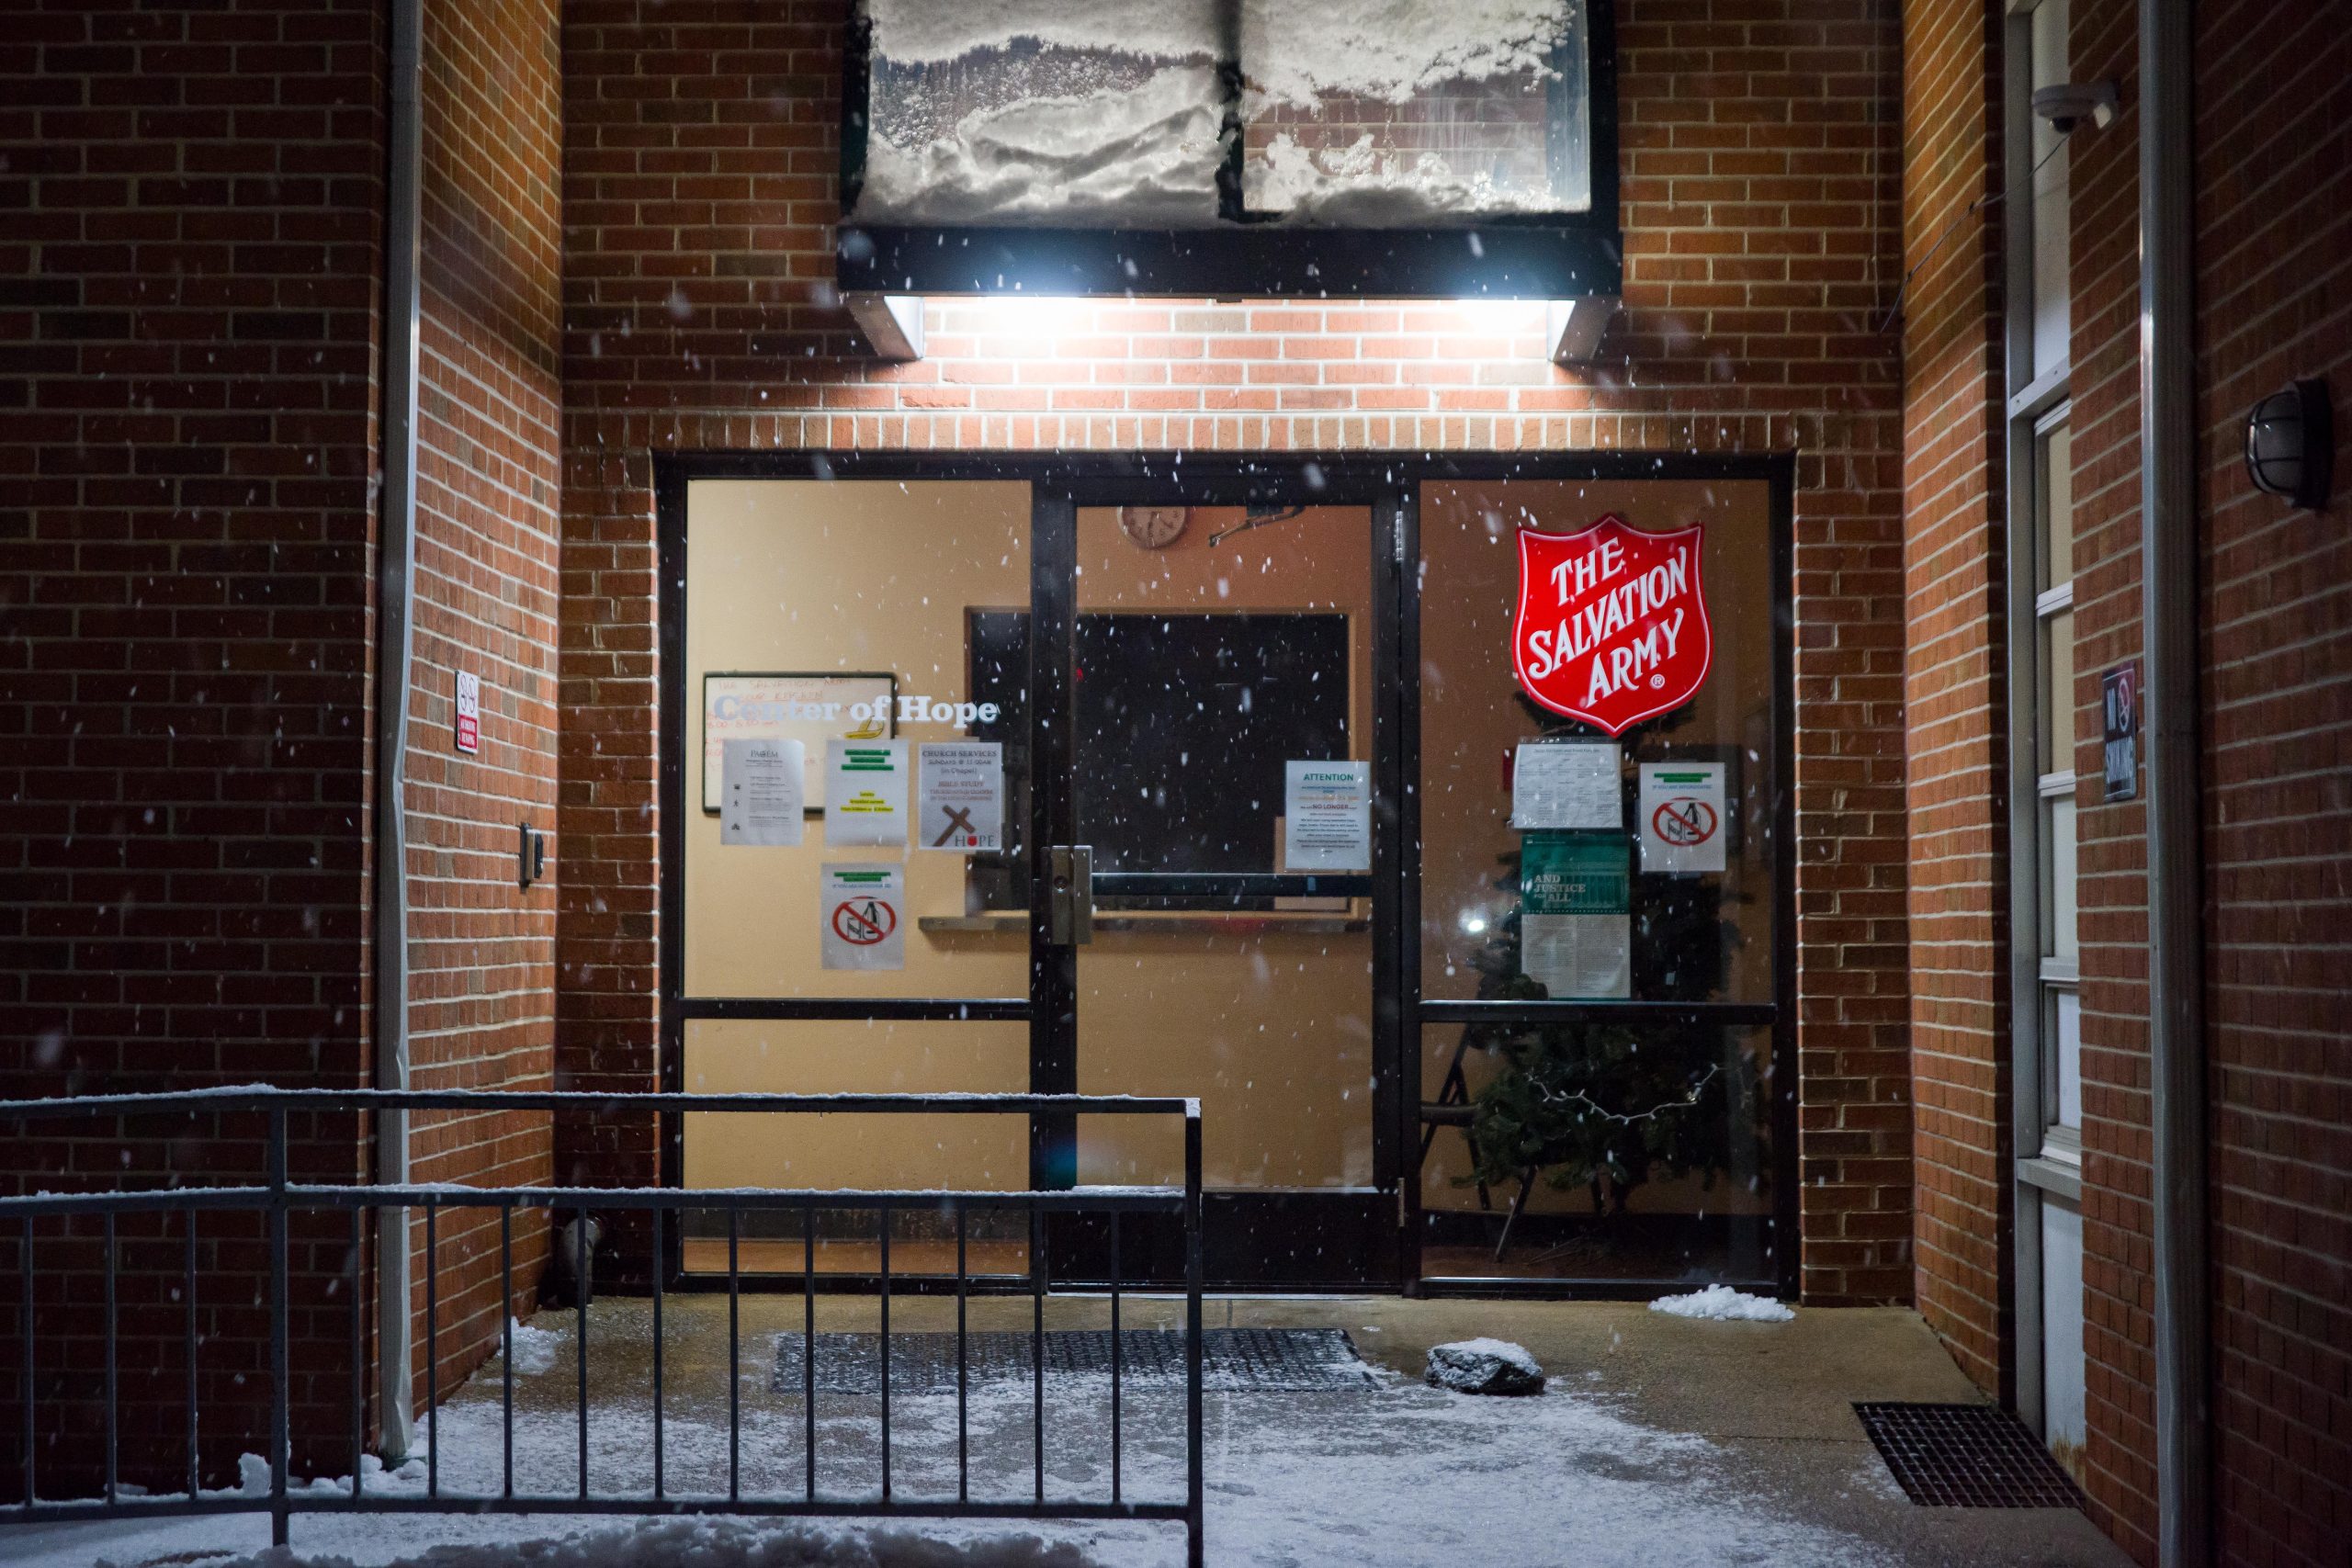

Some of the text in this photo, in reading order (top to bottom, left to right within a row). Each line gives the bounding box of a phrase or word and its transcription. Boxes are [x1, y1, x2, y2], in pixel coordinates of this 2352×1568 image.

[1551, 536, 1624, 606] THE
[1528, 546, 1688, 680] SALVATION
[1586, 607, 1684, 708] ARMY
[714, 694, 841, 721] Center
[850, 694, 891, 721] of
[897, 695, 998, 728] Hope
[1303, 773, 1354, 781] ATTENTION
[1533, 883, 1586, 893] JUSTICE
[1534, 874, 1561, 883] AND
[1547, 894, 1571, 902] ALL
